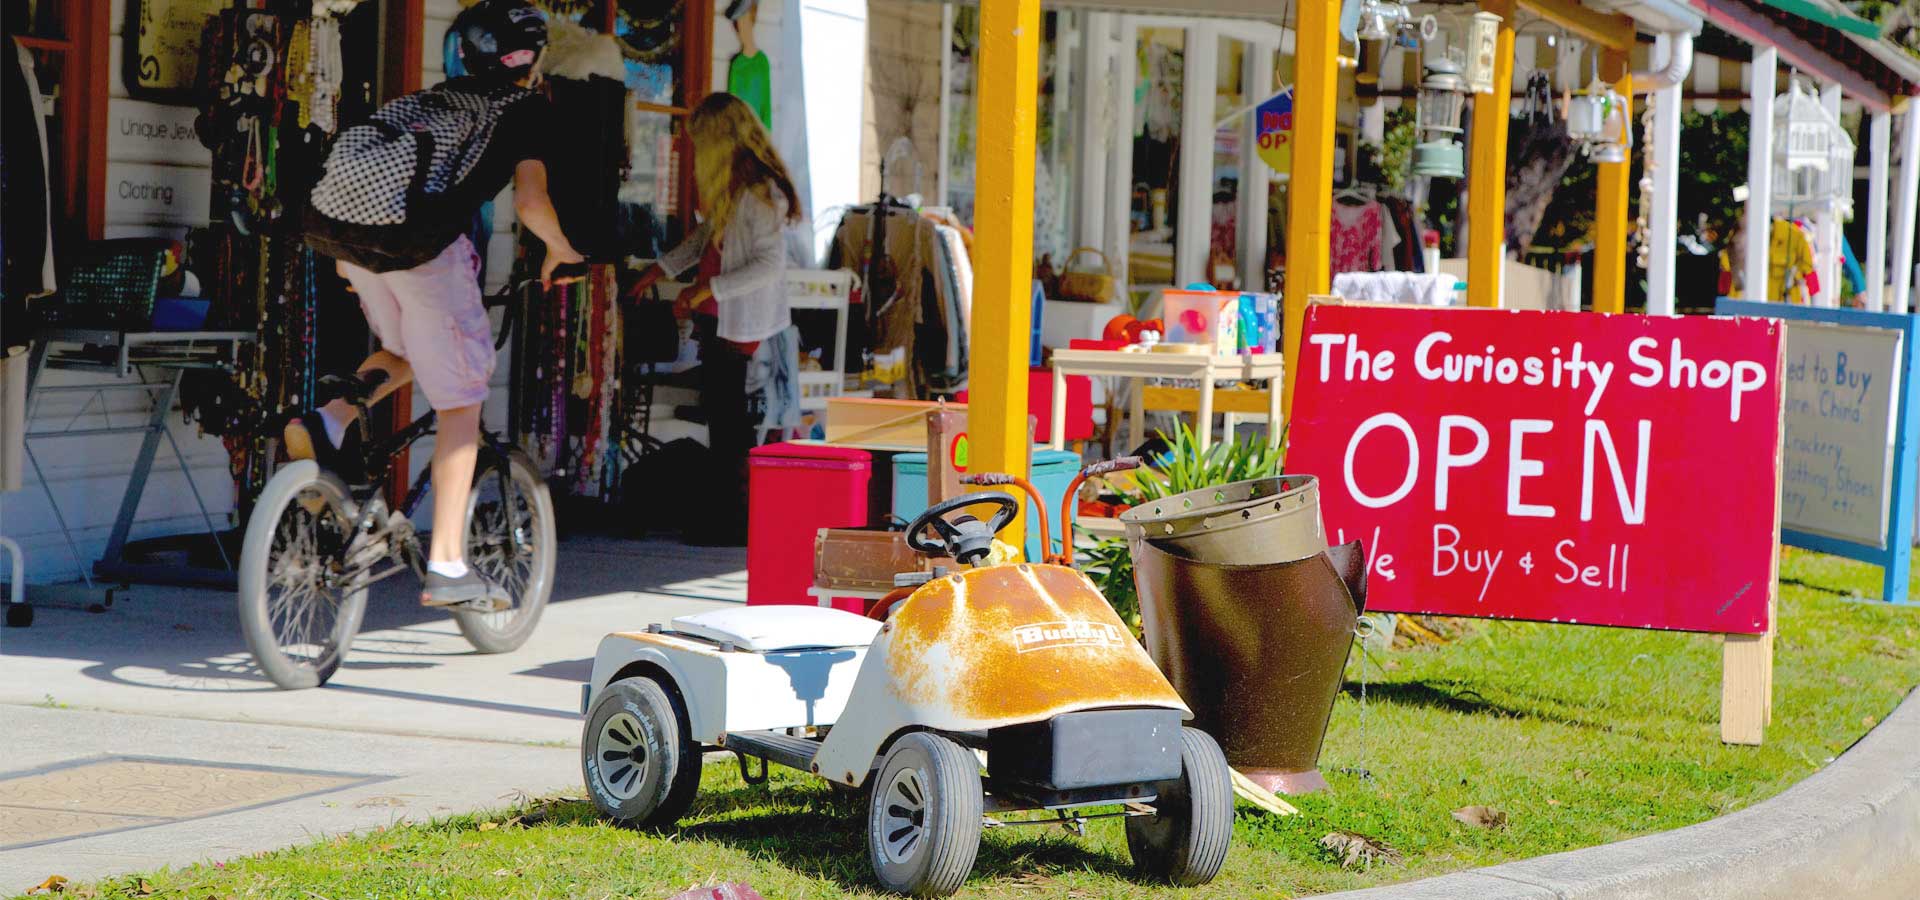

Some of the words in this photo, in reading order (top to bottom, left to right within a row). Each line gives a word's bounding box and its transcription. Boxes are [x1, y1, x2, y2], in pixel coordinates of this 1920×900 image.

[120, 118, 168, 141] Unique
[118, 179, 174, 205] Clothing
[1309, 333, 1395, 383] The
[1414, 331, 1614, 416] Curiosity
[1628, 336, 1767, 422] Shop
[1813, 351, 1829, 384] to
[1836, 352, 1871, 403] Buy
[1343, 412, 1652, 525] OPEN
[1432, 523, 1503, 602] Buy
[1554, 539, 1630, 593] Sell
